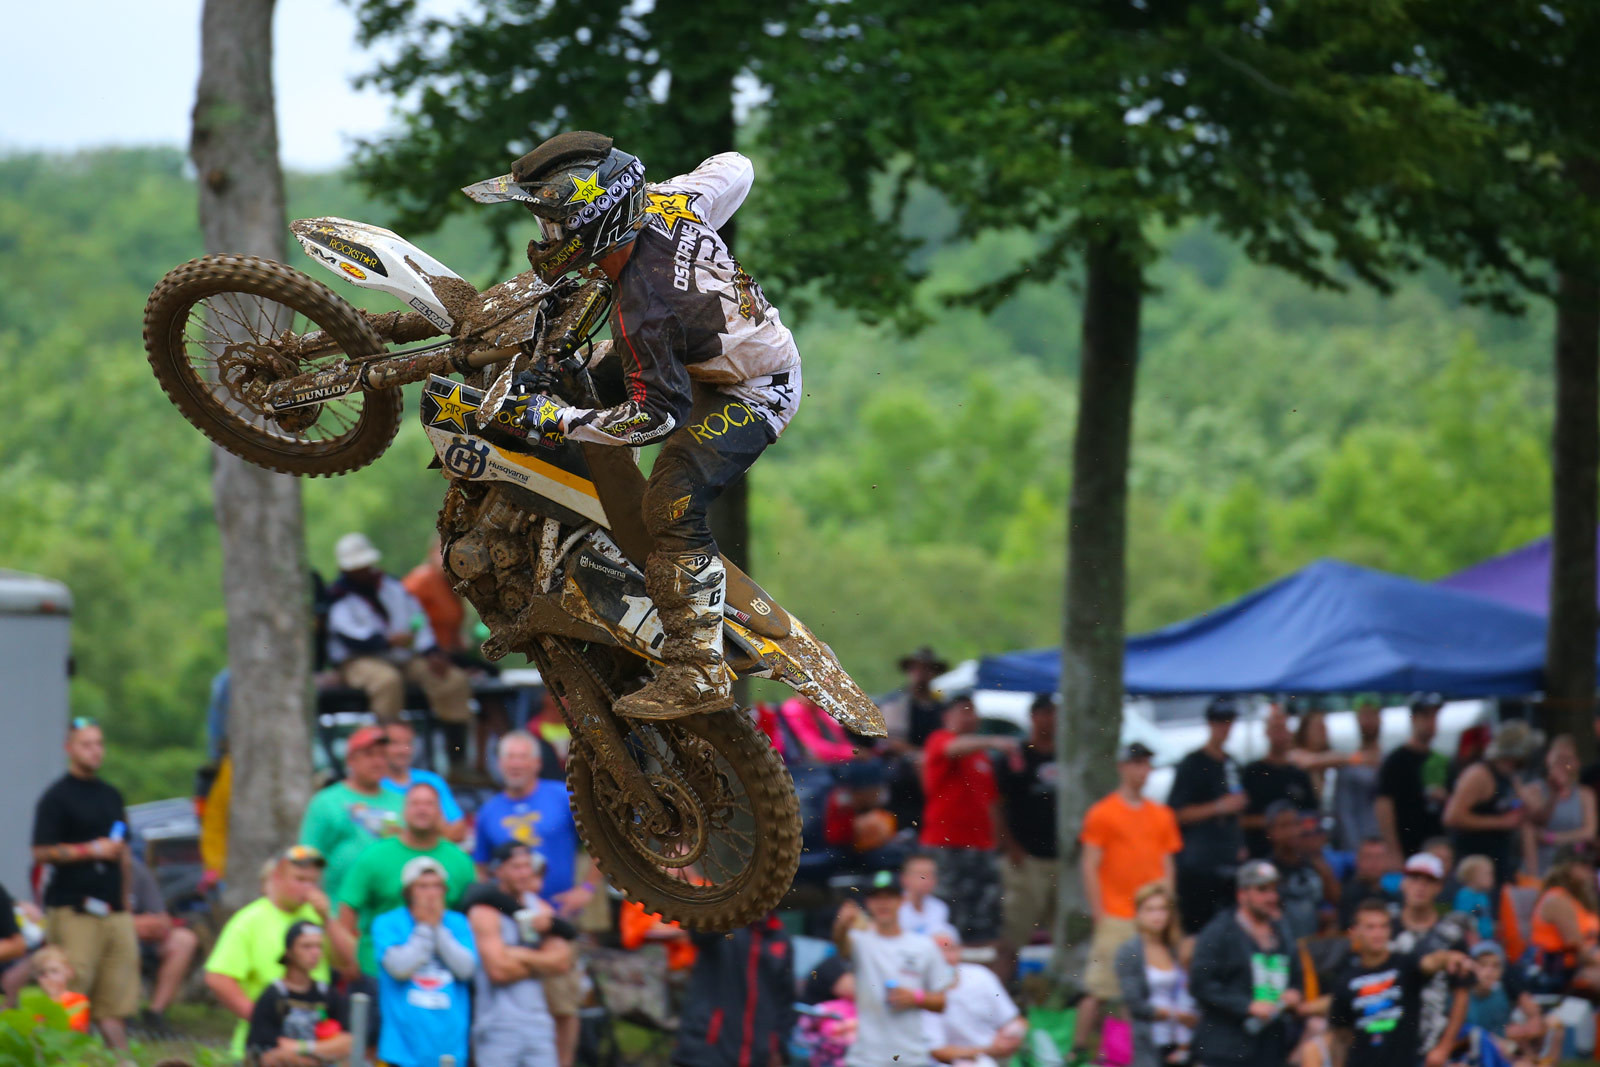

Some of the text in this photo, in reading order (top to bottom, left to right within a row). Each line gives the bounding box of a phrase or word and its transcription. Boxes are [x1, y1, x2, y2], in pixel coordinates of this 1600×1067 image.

[296, 383, 350, 402] DUNLOP
[488, 460, 529, 482] Husqvarna
[588, 560, 626, 579] Husqvarna
